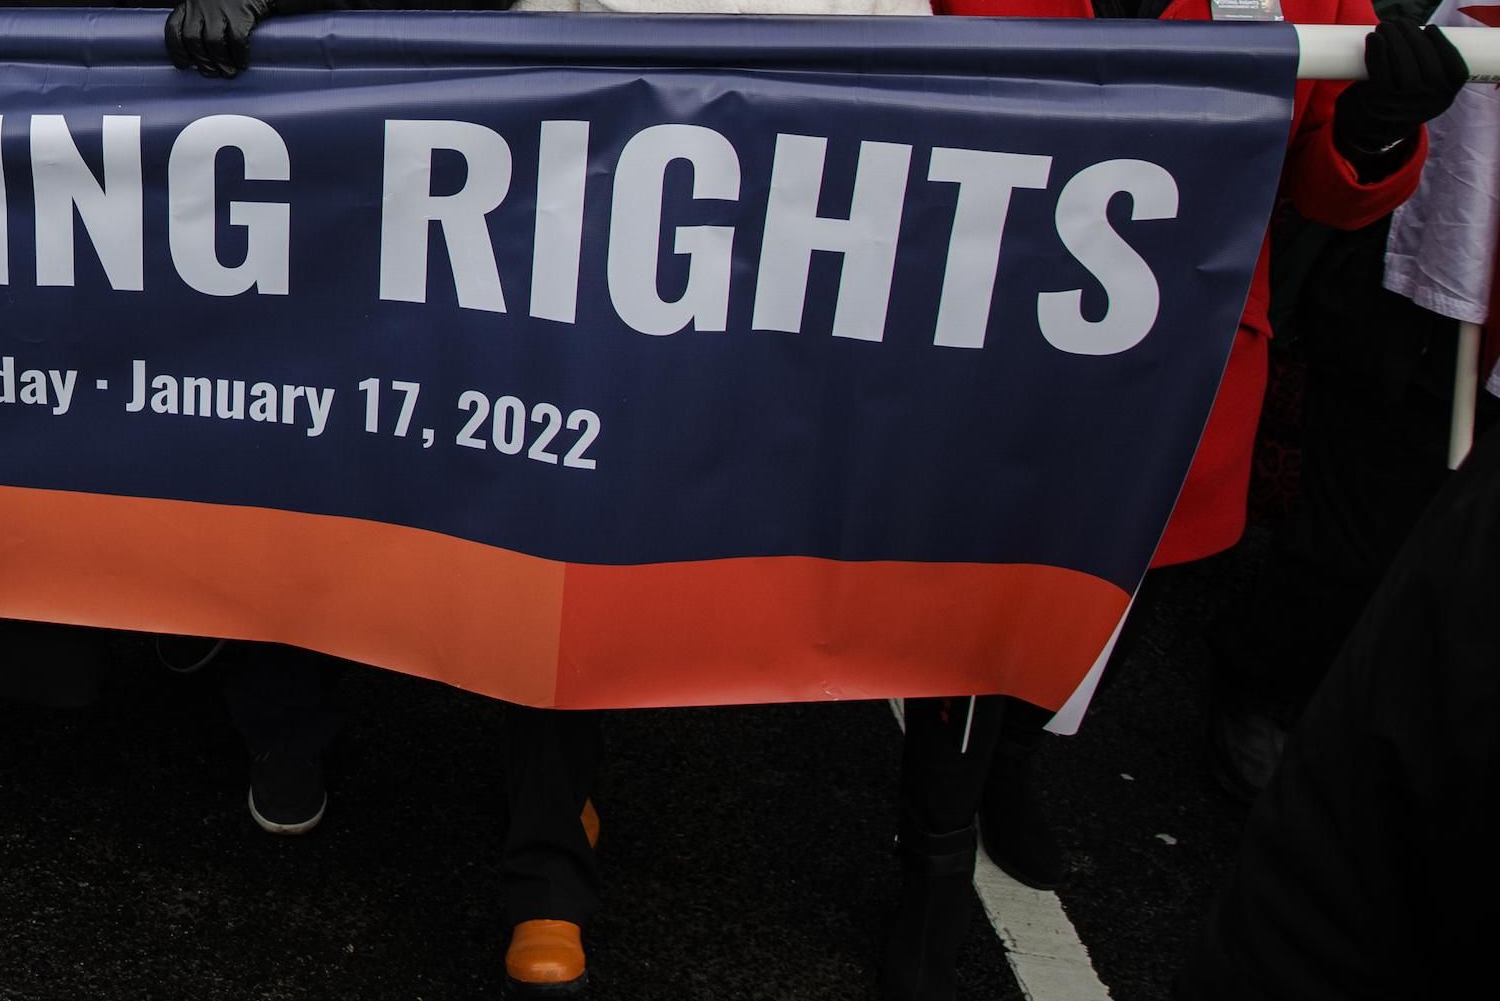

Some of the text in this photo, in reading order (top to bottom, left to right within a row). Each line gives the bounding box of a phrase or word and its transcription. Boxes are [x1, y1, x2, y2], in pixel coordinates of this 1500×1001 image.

[379, 118, 1182, 357] RIGHTS
[126, 361, 335, 438] January
[358, 378, 437, 449] 17,
[456, 389, 602, 471] 2022
